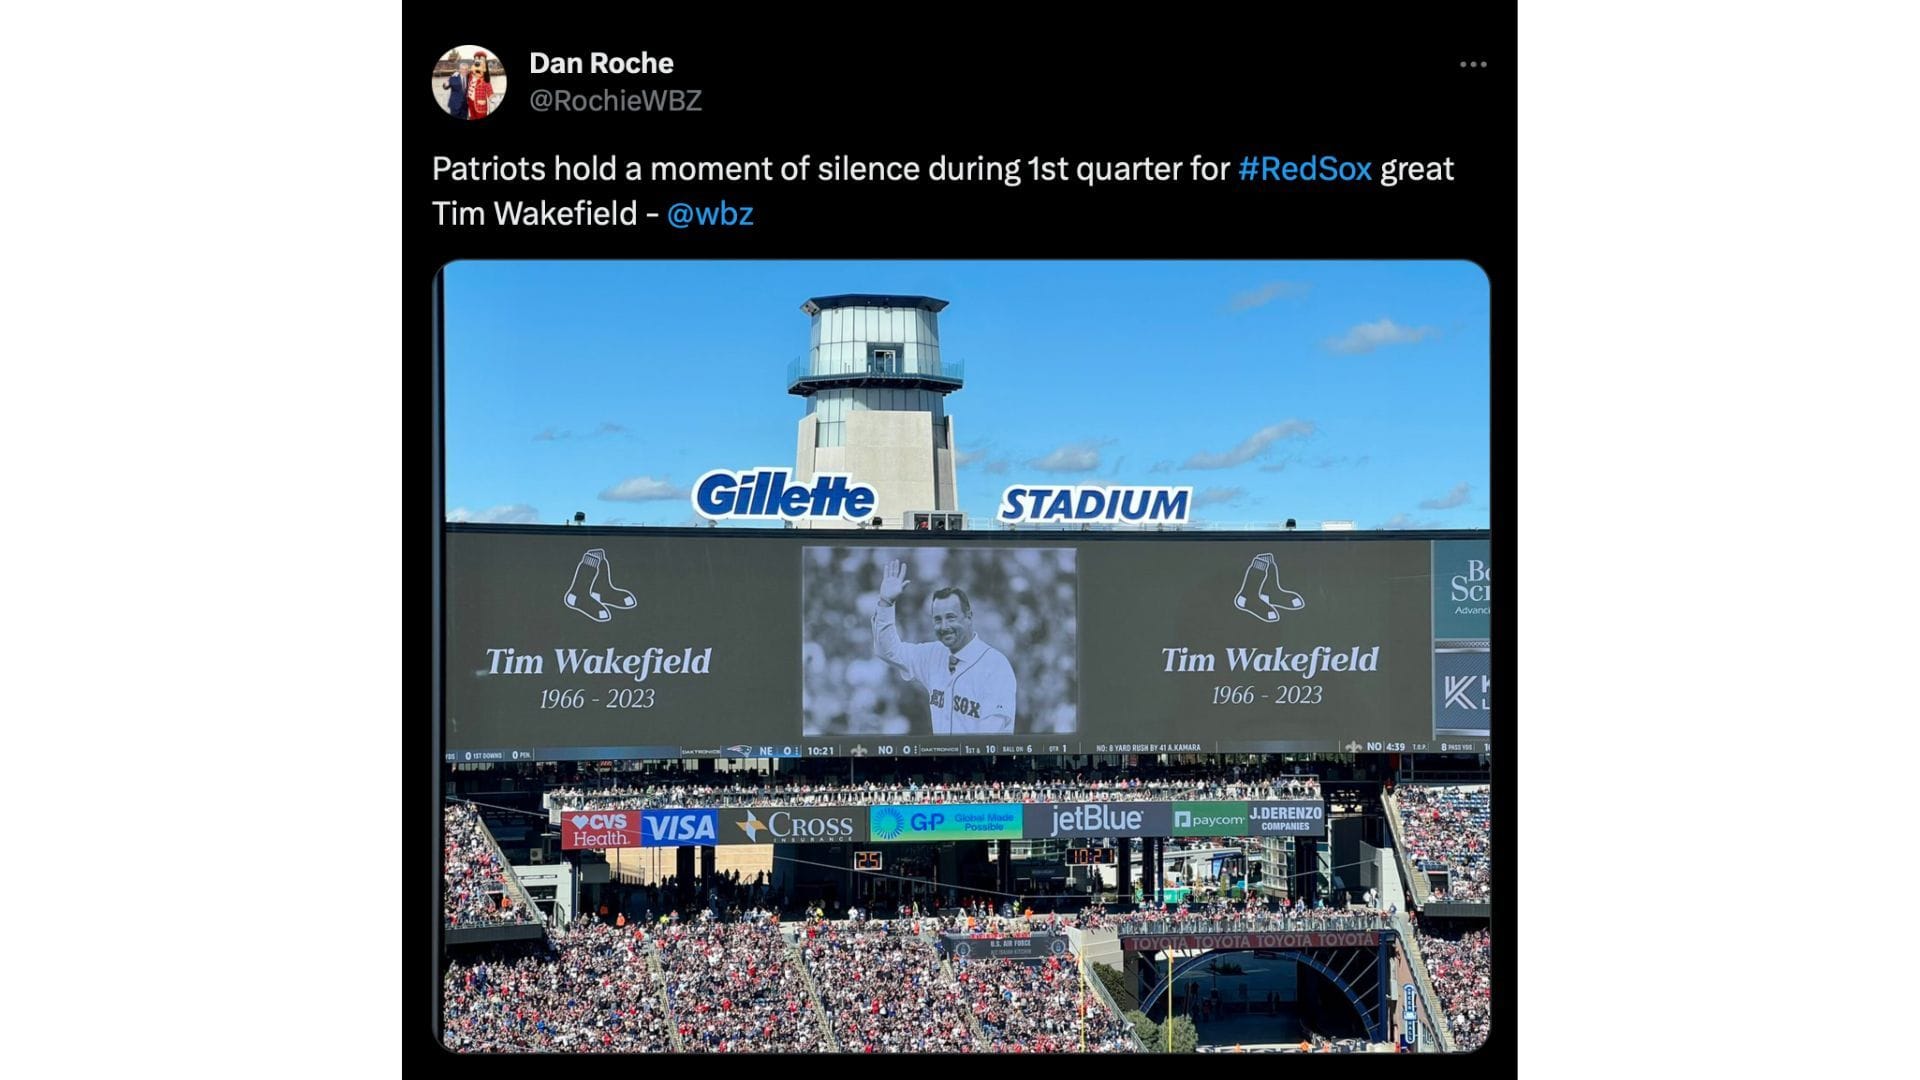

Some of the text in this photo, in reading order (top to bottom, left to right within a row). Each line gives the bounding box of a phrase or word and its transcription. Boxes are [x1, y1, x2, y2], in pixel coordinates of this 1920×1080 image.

[696, 470, 876, 518] Gillette
[1001, 487, 1189, 520] STADIUM
[486, 647, 713, 682] Tim Wakefield
[1161, 645, 1380, 680] Tim Wakefield
[540, 688, 585, 709] 1966
[606, 688, 656, 709] 2023
[1212, 685, 1255, 705] 1966
[1275, 685, 1323, 704] 2023
[953, 695, 981, 719] SOX
[759, 746, 792, 756] NE 0
[807, 746, 834, 755] 10:21
[878, 745, 911, 755] NO 0
[986, 745, 996, 754] 10
[1026, 744, 1033, 753] 6
[1062, 744, 1067, 753] 1
[1114, 744, 1132, 752] YARD
[1132, 744, 1149, 752] RUSH
[1150, 744, 1158, 752] BY
[1159, 744, 1167, 752] 41
[1367, 742, 1406, 751] NO 4:39
[1441, 743, 1447, 752] 8
[465, 752, 472, 761] 0
[512, 751, 519, 760] 0
[954, 813, 1014, 824] Global Made
[1050, 803, 1144, 837] jetBlue
[1249, 806, 1322, 820] J.DERENZO
[589, 813, 628, 830] CVS
[642, 814, 716, 841] VISA
[964, 822, 1004, 832] Possible
[1192, 815, 1245, 827] paycom
[1261, 822, 1310, 831] COMPANIES
[573, 830, 628, 847] Health
[857, 852, 879, 868] 25
[1073, 848, 1115, 865] 10:21
[1132, 937, 1188, 951] TOYOTA
[1195, 935, 1250, 949] TOYOTA
[1257, 934, 1313, 948] TOYOTA
[1317, 932, 1374, 947] TOYOTA
